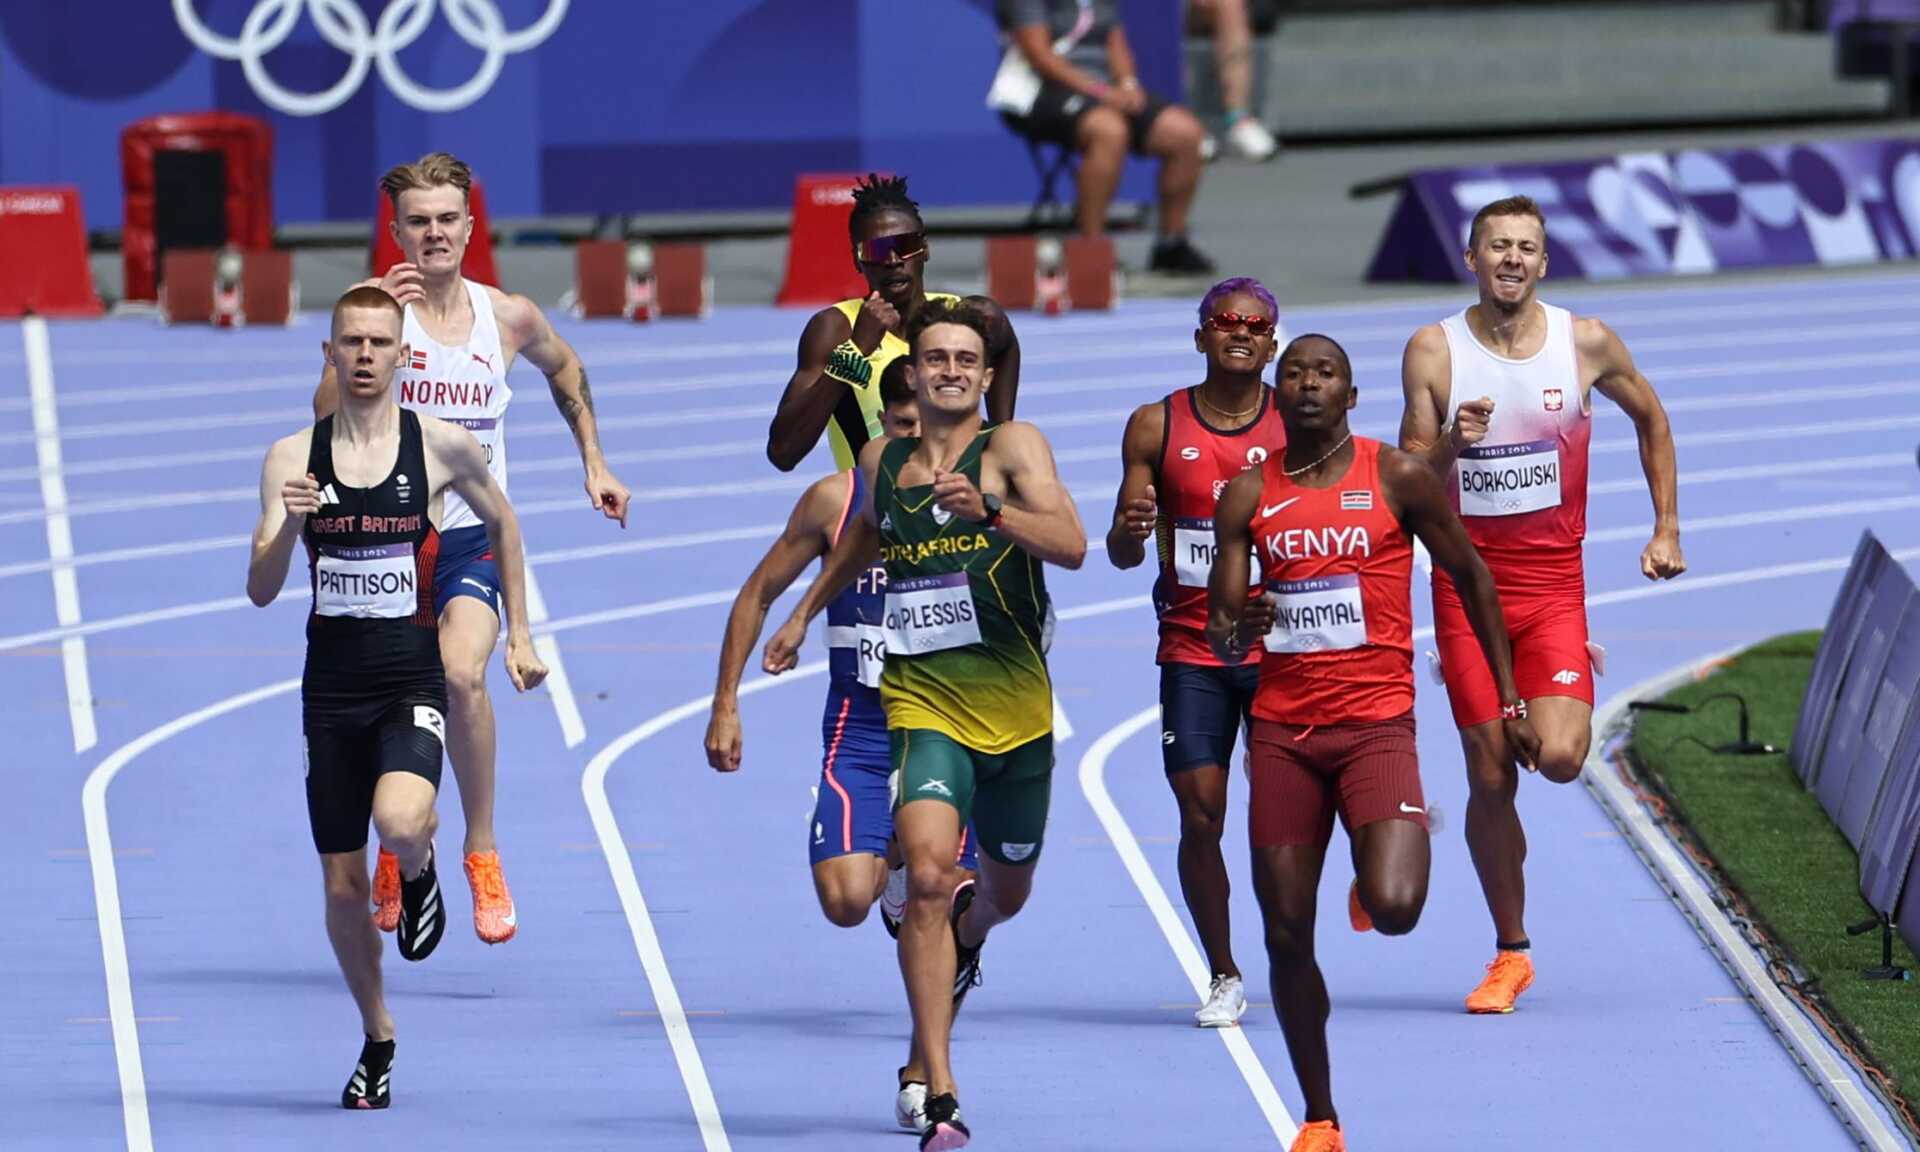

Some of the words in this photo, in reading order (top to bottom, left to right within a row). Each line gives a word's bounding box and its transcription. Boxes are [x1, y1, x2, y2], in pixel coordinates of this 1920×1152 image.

[400, 380, 493, 408] NORWAY
[1508, 446, 1531, 455] 2024
[1462, 463, 1557, 492] BORKOWSKI
[312, 516, 355, 534] GREAT
[361, 514, 421, 533] BRITAIN
[917, 533, 990, 558] AFRICA
[1266, 526, 1370, 563] KENYA
[320, 570, 414, 595] PATTISON
